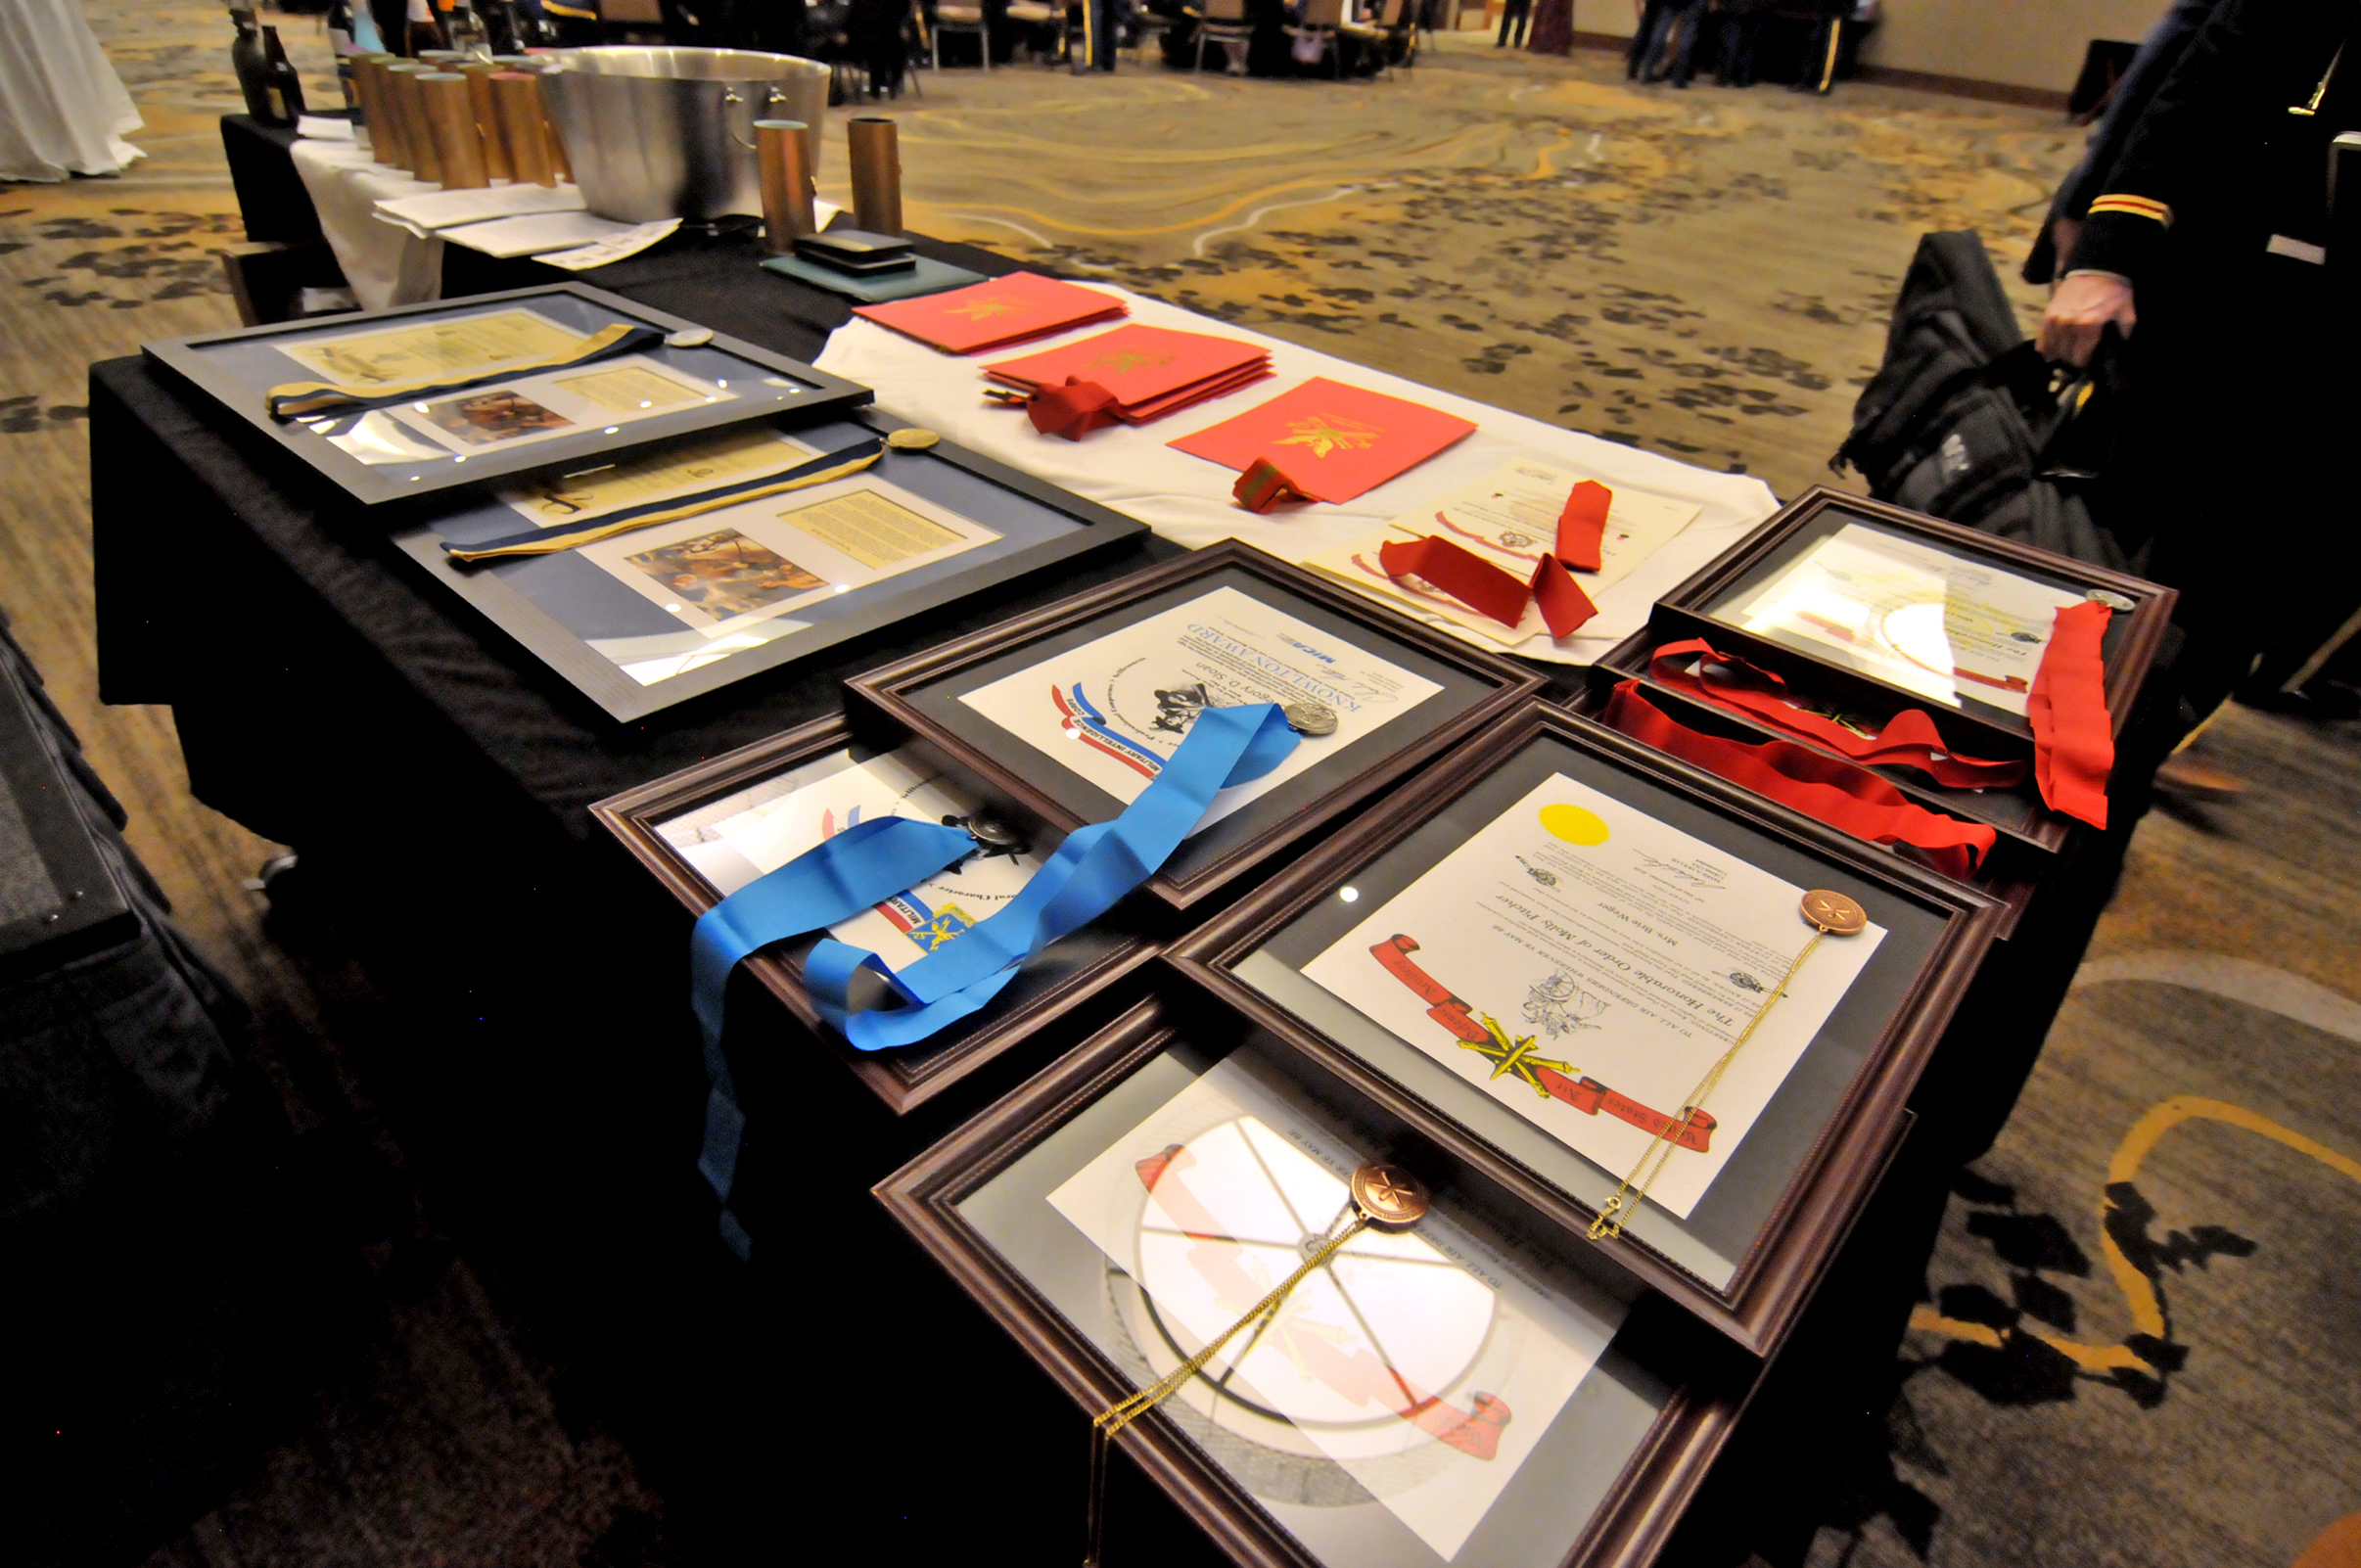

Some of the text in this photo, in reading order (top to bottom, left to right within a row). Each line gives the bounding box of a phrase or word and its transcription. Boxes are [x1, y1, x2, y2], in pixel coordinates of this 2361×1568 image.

[1186, 623, 1254, 657] AWARD
[1292, 642, 1335, 663] MICA
[1194, 663, 1227, 679] Sloan
[1227, 678, 1241, 687] D.
[1250, 656, 1362, 712] KNOWLTON
[1067, 699, 1162, 771] MILITARY INTELLIGENCE CORPS
[938, 887, 991, 901] Character
[1597, 902, 1678, 945] Mrs. Brie Weger
[1505, 932, 1523, 943] MAY
[1495, 895, 1733, 1027] The Honorable Order of Molly Pitcher
[1537, 950, 1584, 978] WHEREVER
[1587, 978, 1638, 1007] DEFENDERS
[1437, 1007, 1479, 1039] Defense
[1640, 1007, 1657, 1017] AIR
[1659, 1017, 1678, 1029] ALL
[1679, 1029, 1692, 1038] TO
[1555, 1083, 1581, 1101] Air
[1607, 1098, 1647, 1124] States
